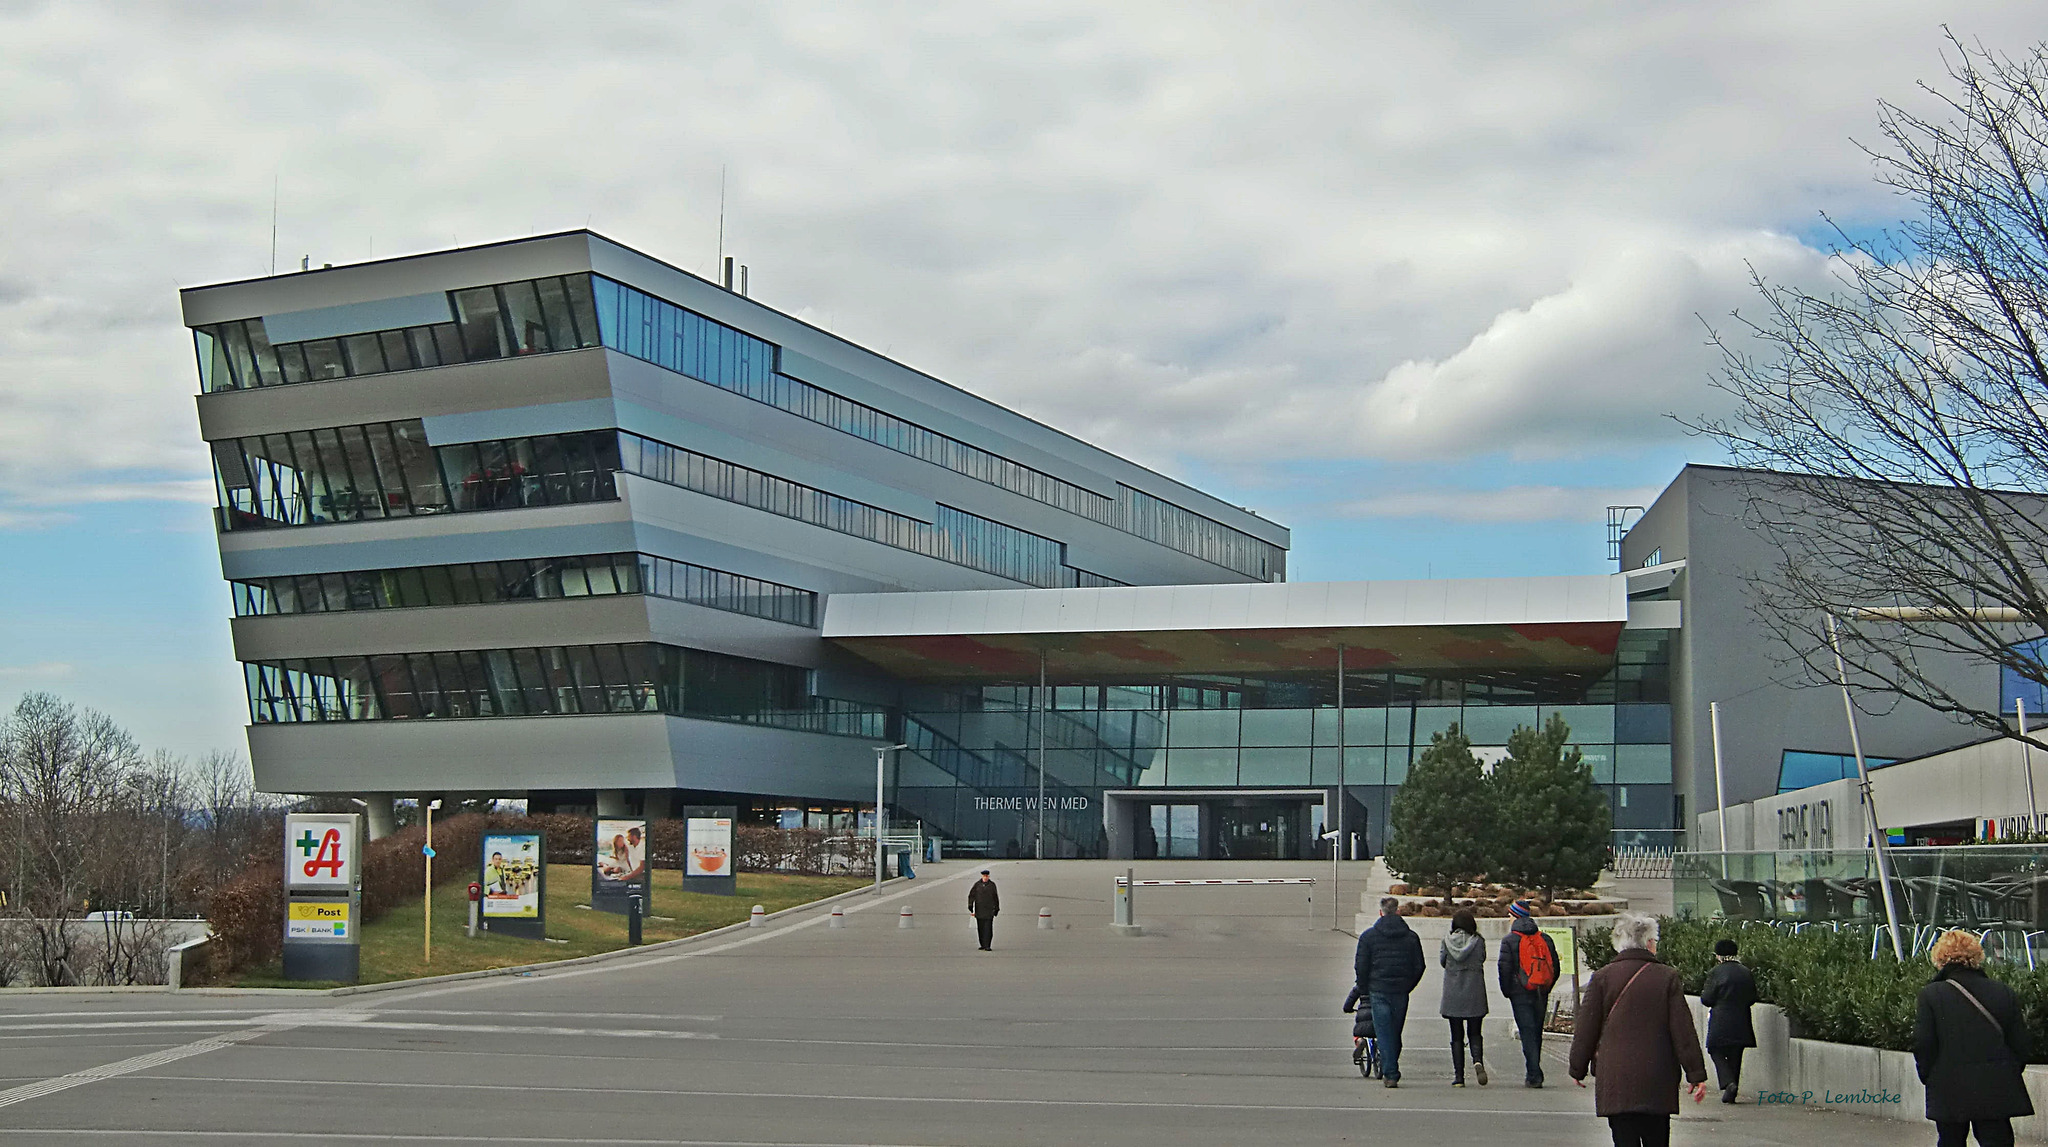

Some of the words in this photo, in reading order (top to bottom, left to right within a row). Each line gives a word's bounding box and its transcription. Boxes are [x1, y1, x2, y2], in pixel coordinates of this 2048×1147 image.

[974, 797, 1022, 810] THERME
[1025, 797, 1057, 810] WEN
[1060, 797, 1088, 810] MED
[317, 908, 341, 917] Post
